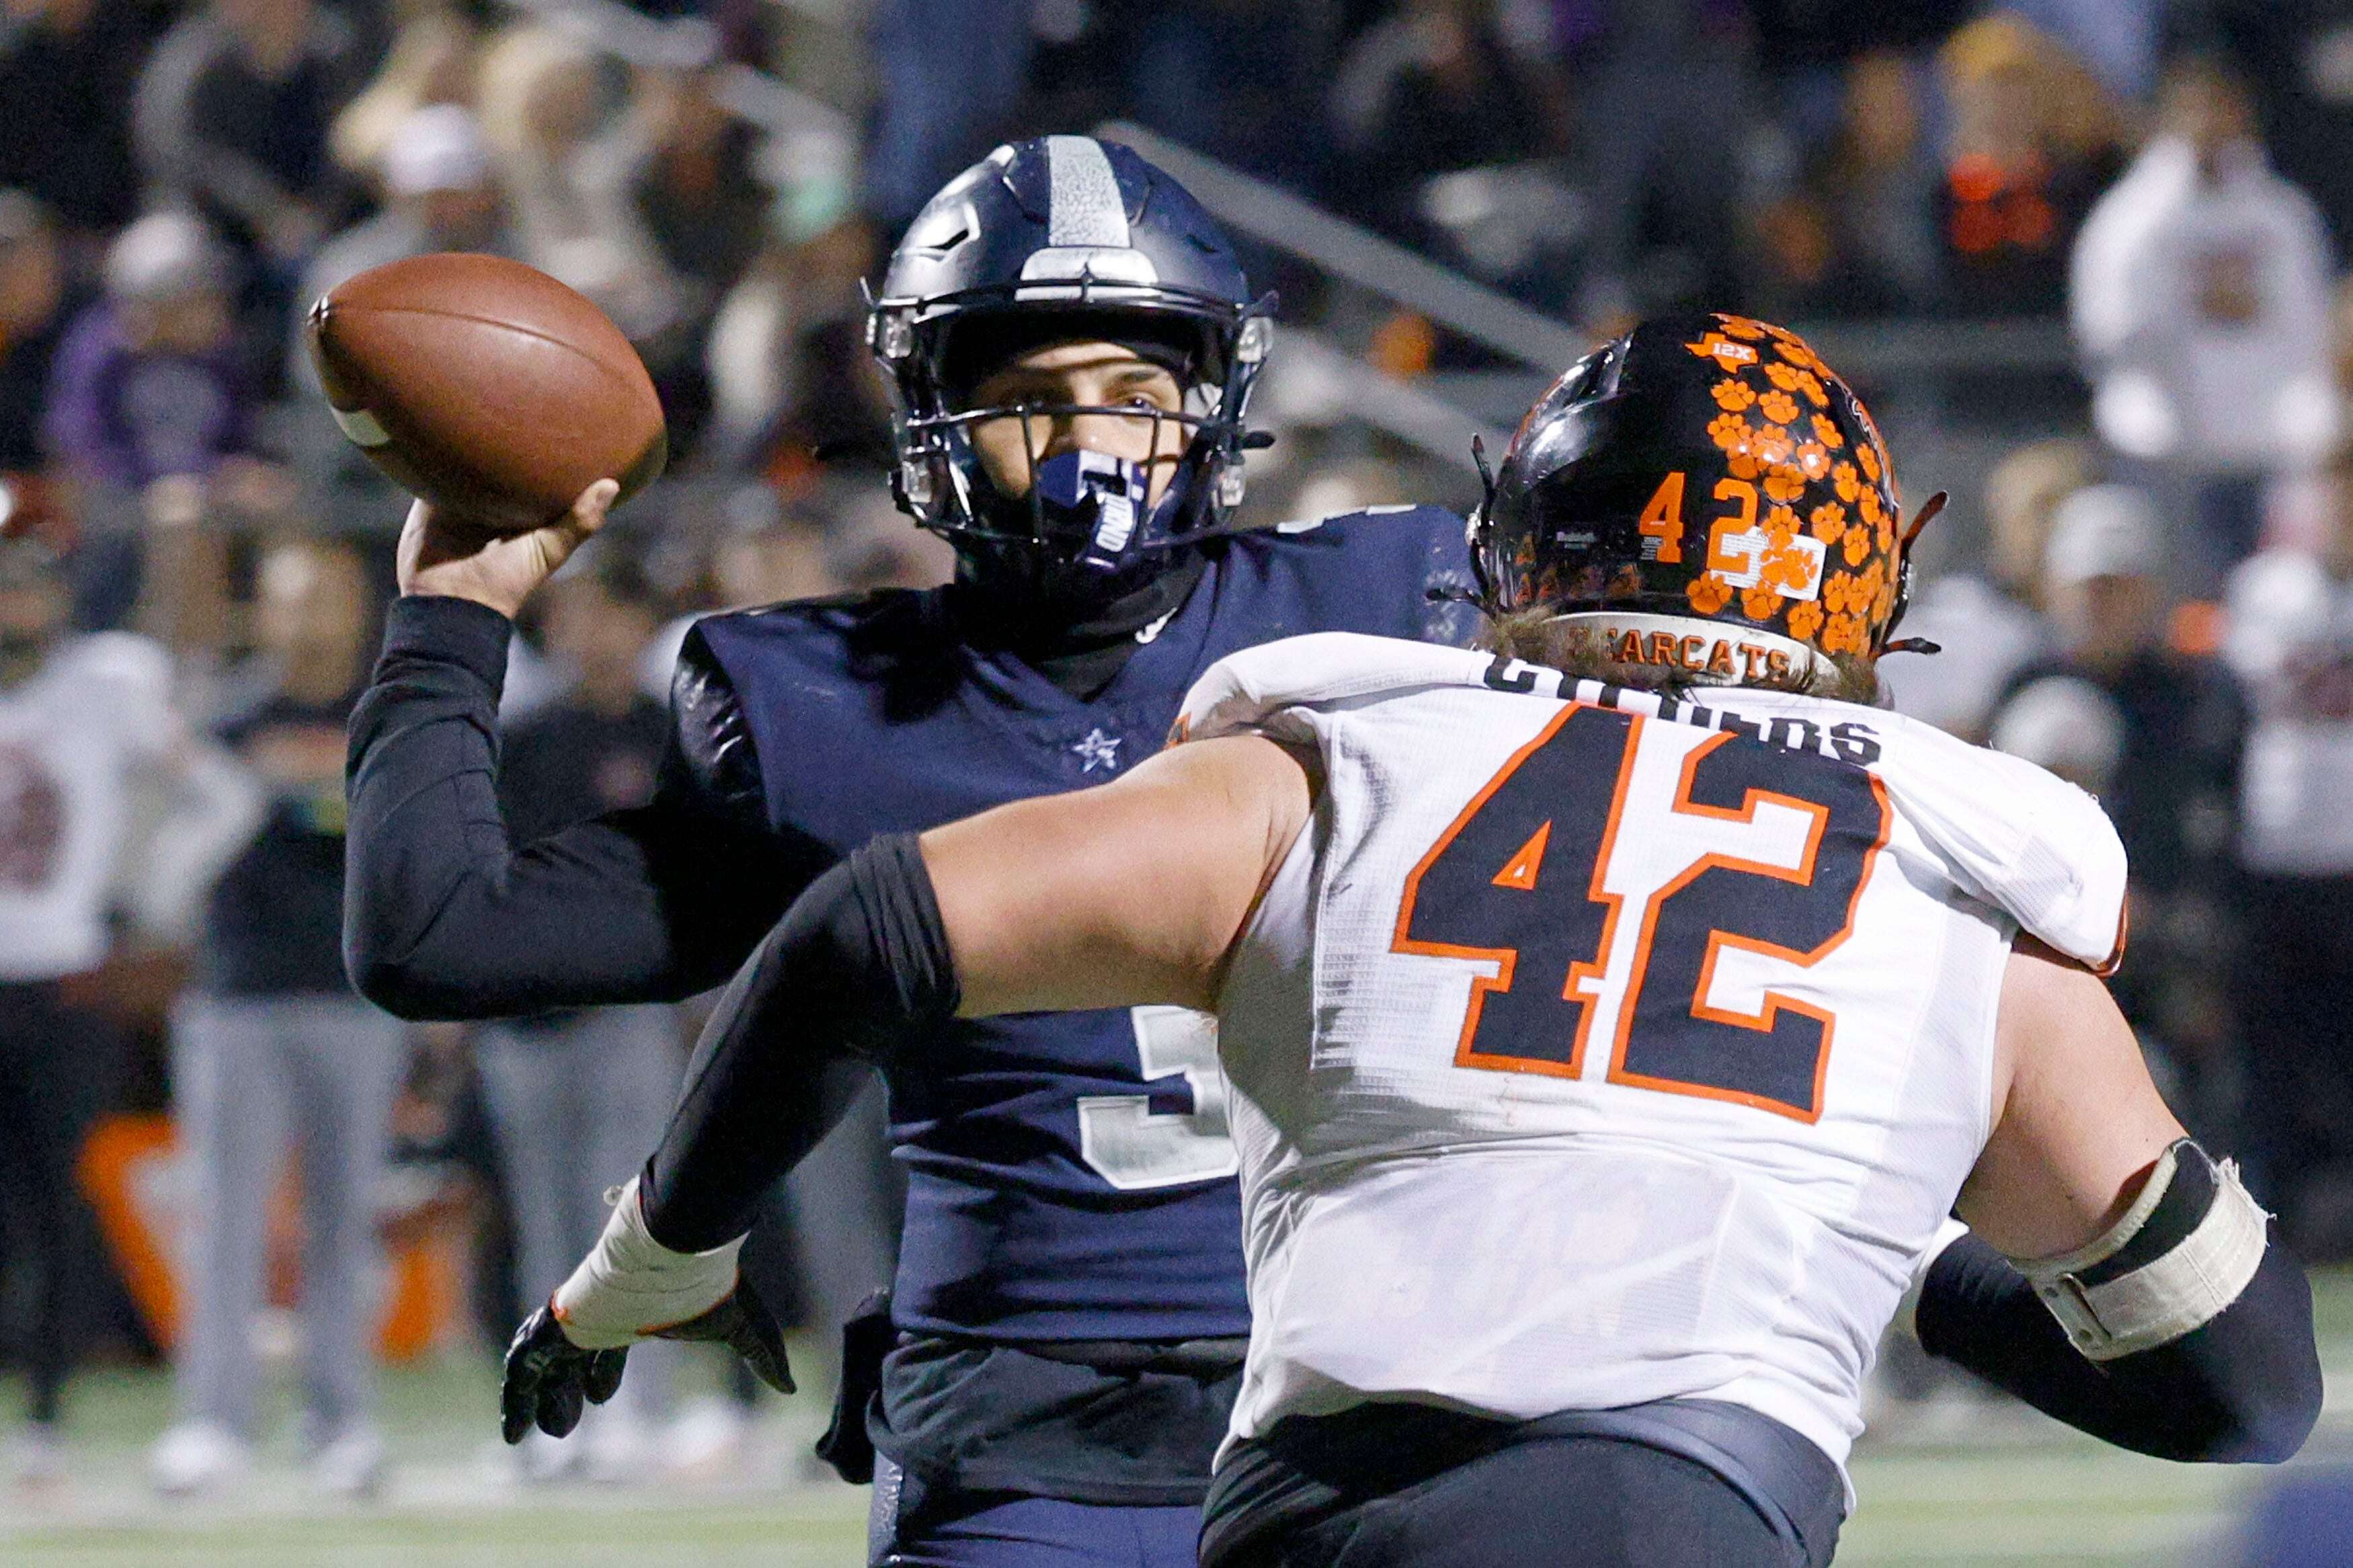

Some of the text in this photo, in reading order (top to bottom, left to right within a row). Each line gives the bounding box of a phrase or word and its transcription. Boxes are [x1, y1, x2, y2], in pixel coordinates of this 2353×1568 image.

[1638, 470, 1759, 574] 42
[1570, 626, 1790, 680] ARCATS
[1390, 701, 1894, 1126] 42
